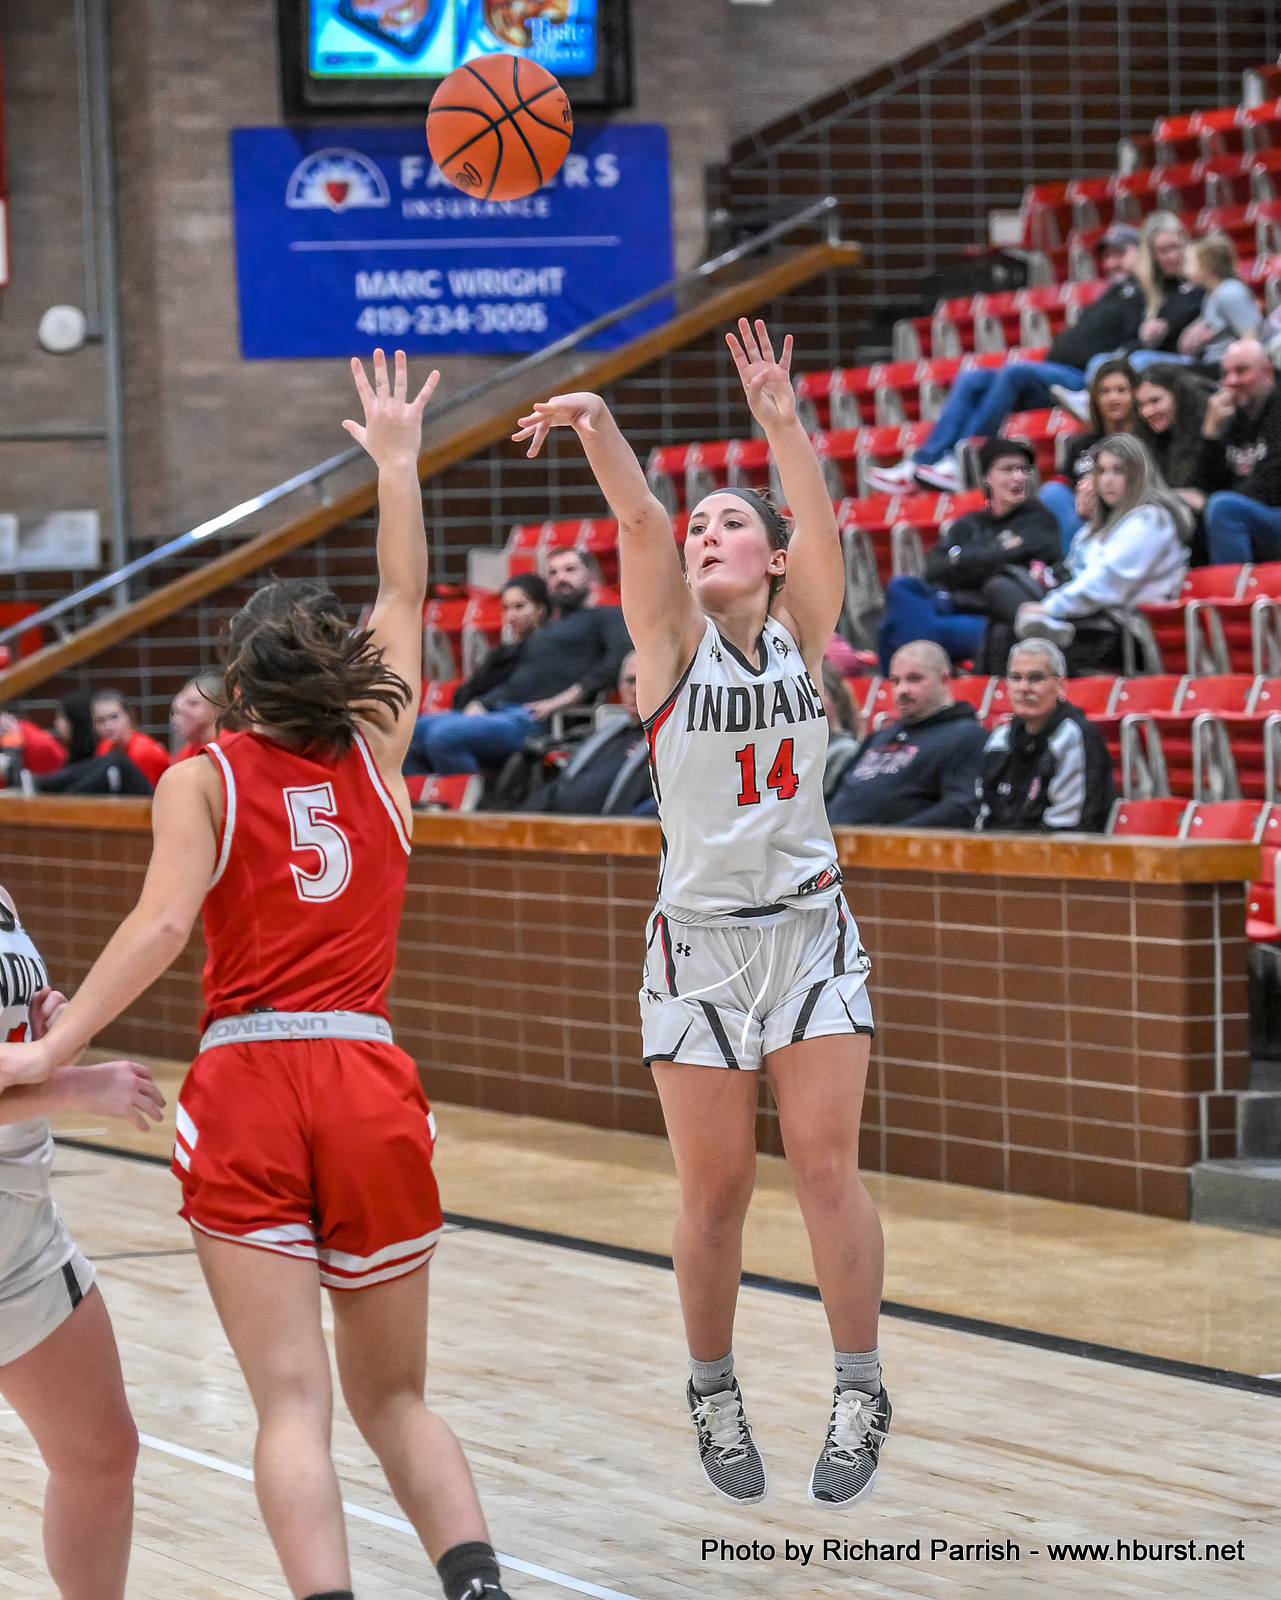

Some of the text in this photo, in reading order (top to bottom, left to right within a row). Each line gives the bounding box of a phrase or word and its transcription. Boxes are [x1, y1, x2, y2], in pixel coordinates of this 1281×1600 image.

[400, 153, 620, 190] FARS
[355, 266, 565, 300] MARC WRIGHT
[735, 737, 800, 806] 14
[282, 781, 353, 903] 5
